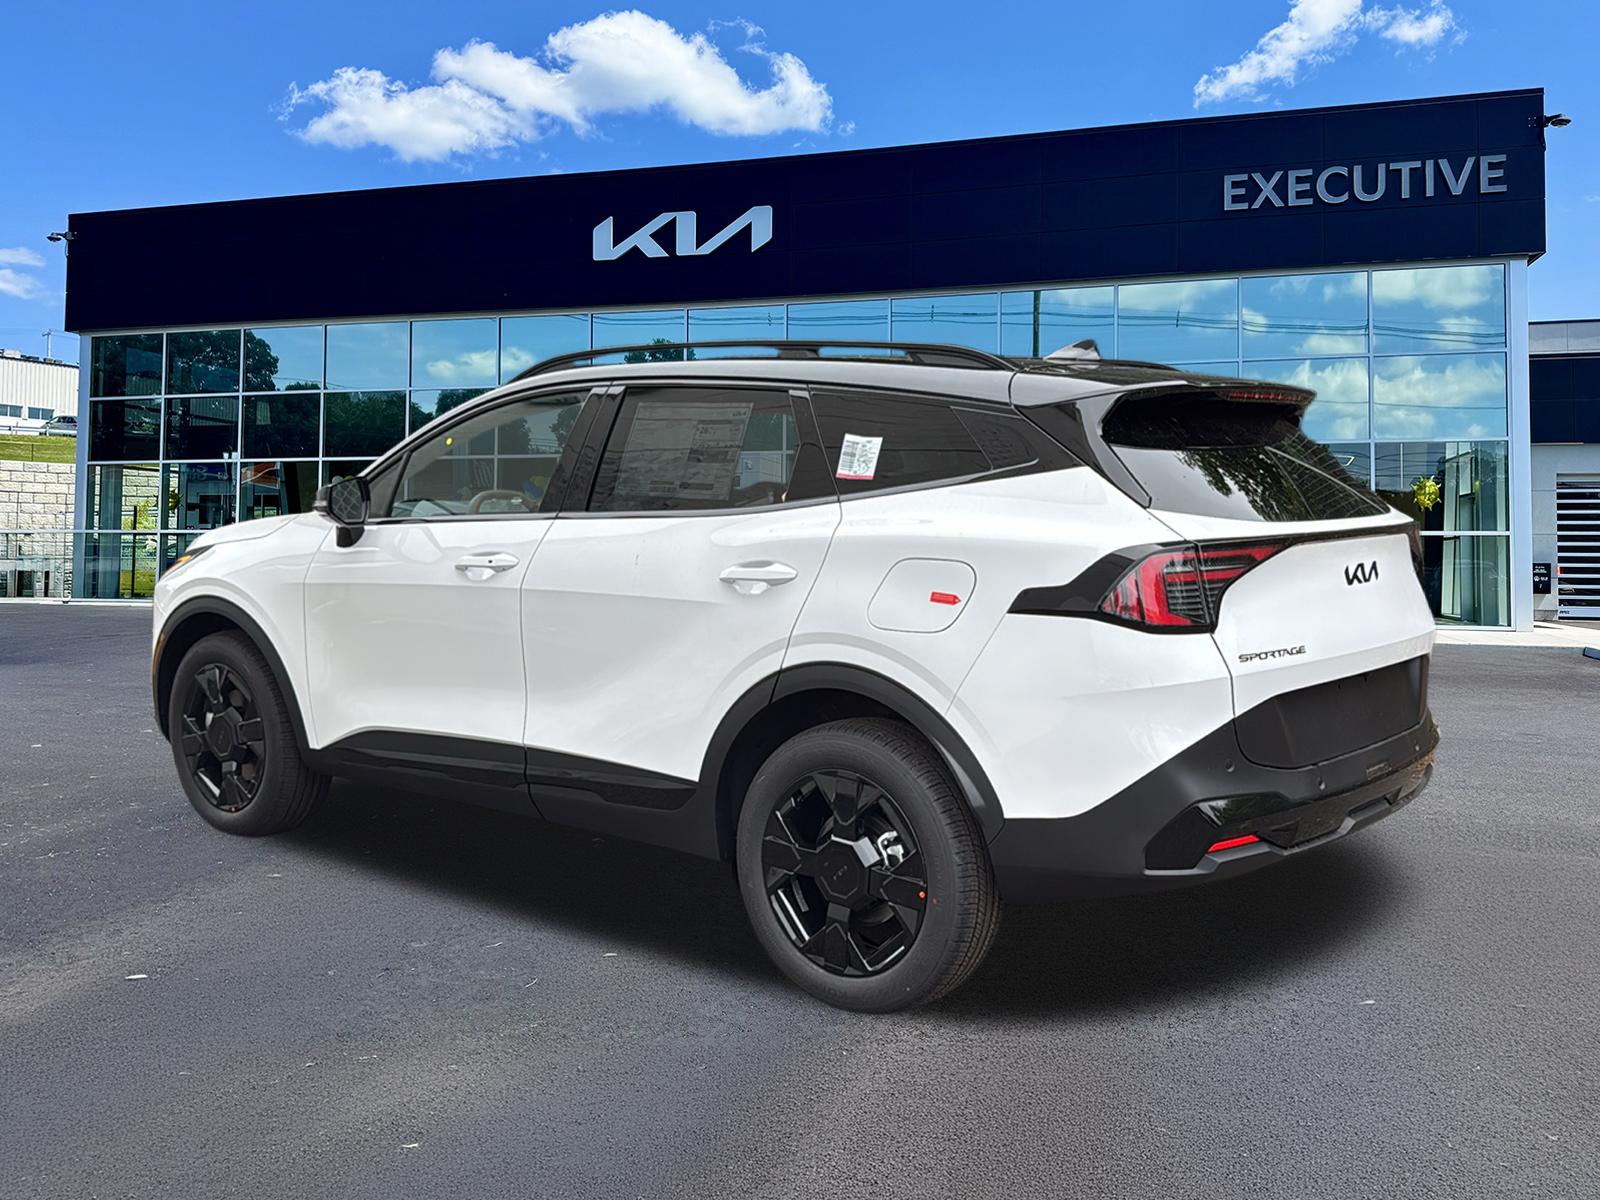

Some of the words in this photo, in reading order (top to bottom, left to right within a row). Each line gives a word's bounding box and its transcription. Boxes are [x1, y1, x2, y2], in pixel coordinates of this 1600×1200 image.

[1223, 154, 1507, 211] EXECUTIVE
[592, 205, 773, 261] KIA
[1344, 560, 1379, 586] KIA
[1238, 645, 1307, 663] SPORTAGE
